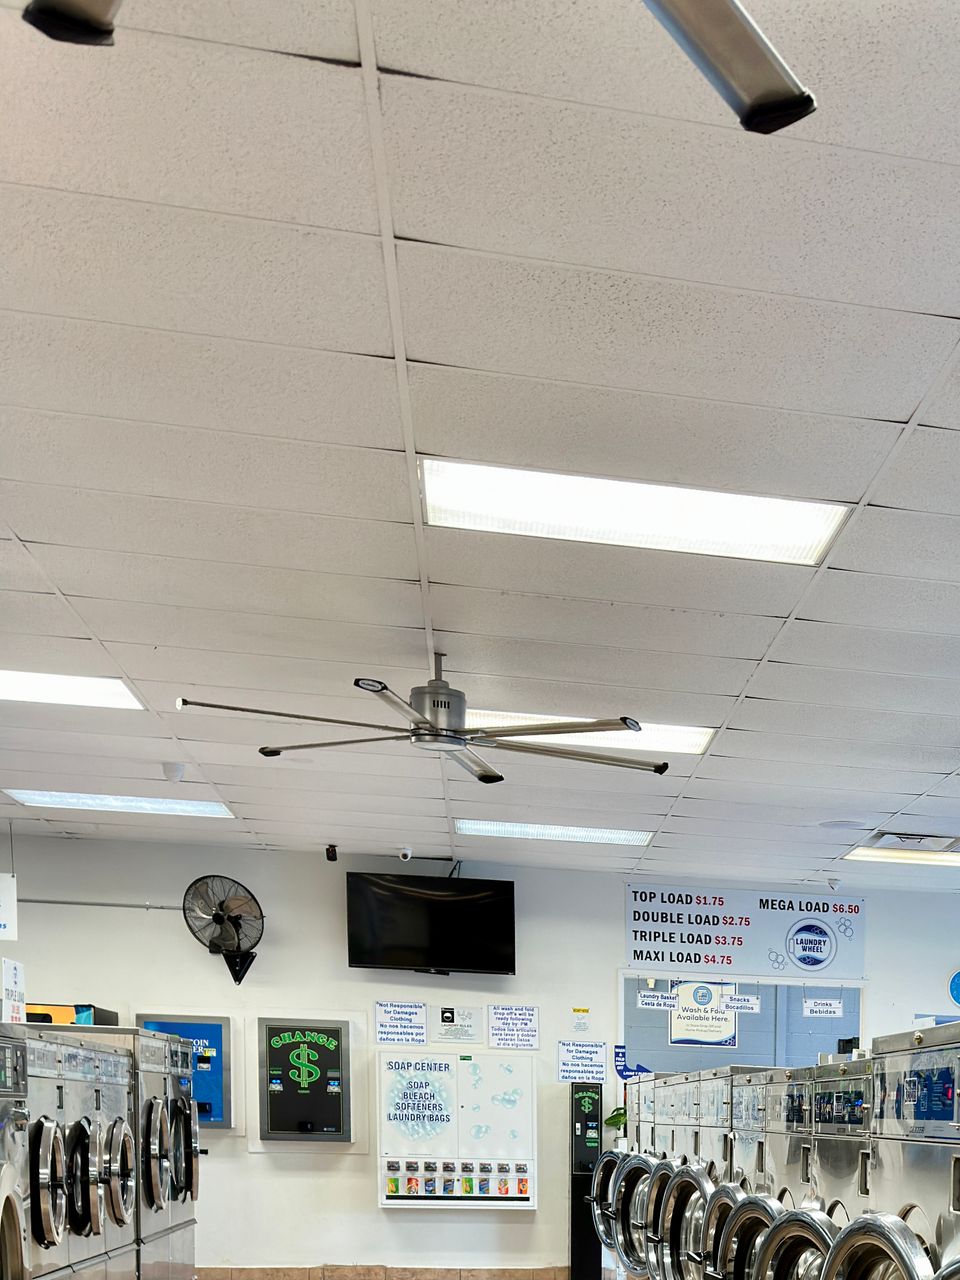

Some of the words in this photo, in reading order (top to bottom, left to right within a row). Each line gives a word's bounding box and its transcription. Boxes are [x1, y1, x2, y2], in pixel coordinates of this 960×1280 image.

[632, 891, 656, 902] TOP
[661, 892, 692, 904] LOAD
[696, 896, 724, 906] $1.75
[760, 899, 794, 911] MEGA
[799, 901, 829, 912] LOAD
[832, 904, 859, 914] $6.50
[633, 910, 684, 924] DOUBLE
[688, 914, 720, 926] LOAD
[722, 916, 750, 926] $2.75
[632, 930, 676, 942] TRIPLE
[680, 933, 711, 945] LOAD
[715, 936, 743, 946] $3.75
[633, 950, 664, 962] MAXI
[670, 952, 701, 963] LOAD
[704, 954, 732, 964] $4.75
[271, 1031, 338, 1051] CHANGE
[388, 1061, 412, 1070] SOAP
[415, 1062, 450, 1072] CENTER
[408, 1081, 430, 1090] SOAP
[403, 1092, 435, 1100] BLEACH
[575, 1092, 599, 1100] CHANGE
[396, 1102, 443, 1111] SOFTENERS
[388, 1113, 425, 1121] LAUNDRY
[429, 1114, 450, 1122] BAGS
